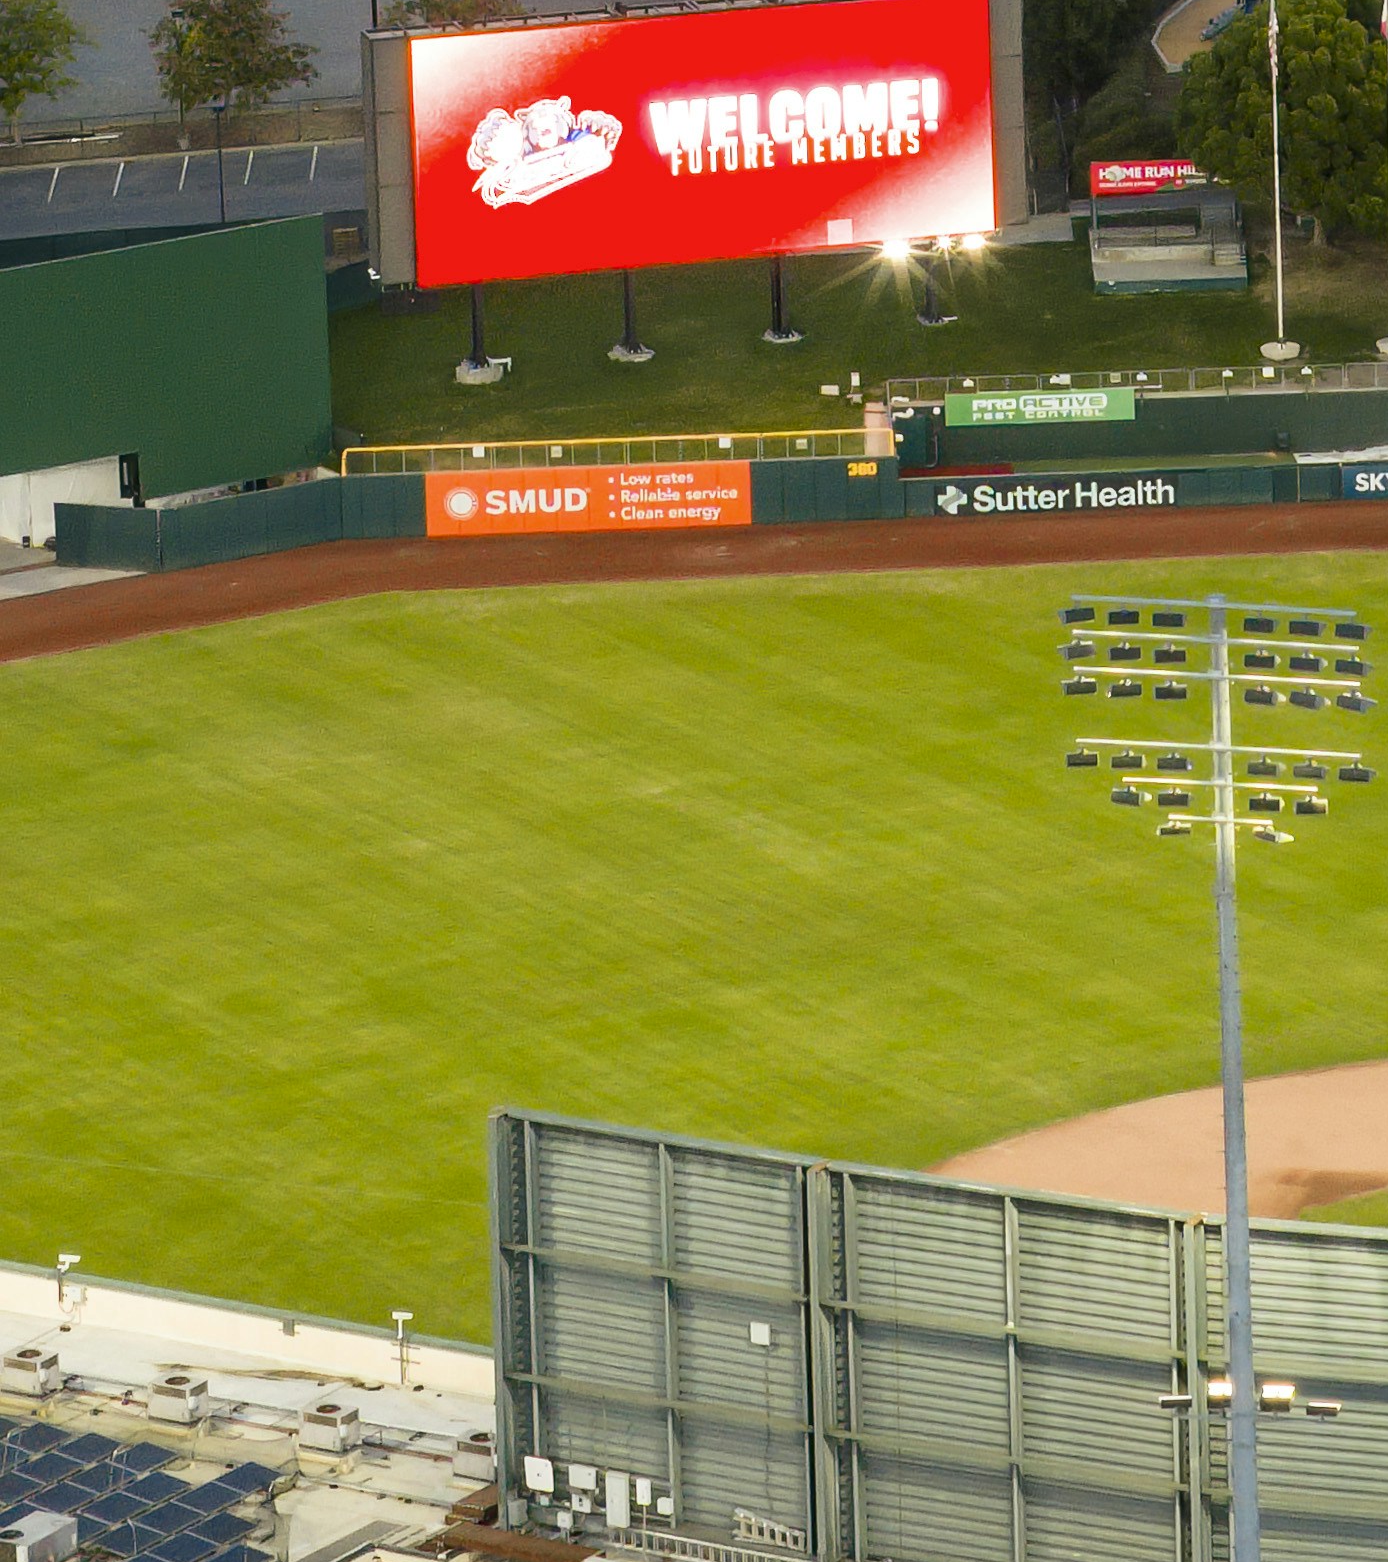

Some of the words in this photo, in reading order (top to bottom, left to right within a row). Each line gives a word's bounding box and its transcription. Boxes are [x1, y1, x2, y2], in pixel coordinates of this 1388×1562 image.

[648, 77, 939, 156] WELCOME!
[671, 139, 775, 176] FUTURE
[791, 128, 922, 166] MEMBERS
[1144, 165, 1175, 178] RUN
[972, 397, 1017, 412] PRO
[1022, 394, 1106, 410] ACTIVE
[1024, 408, 1105, 420] CONTROL
[620, 473, 651, 486] Low
[655, 471, 694, 484] rates
[485, 488, 588, 515] SMUD
[621, 487, 680, 503] Reliable
[685, 487, 739, 500] service
[973, 484, 1070, 513] Sutter
[1074, 478, 1175, 508] Health
[621, 505, 664, 521] Clean
[668, 503, 721, 521] energy
